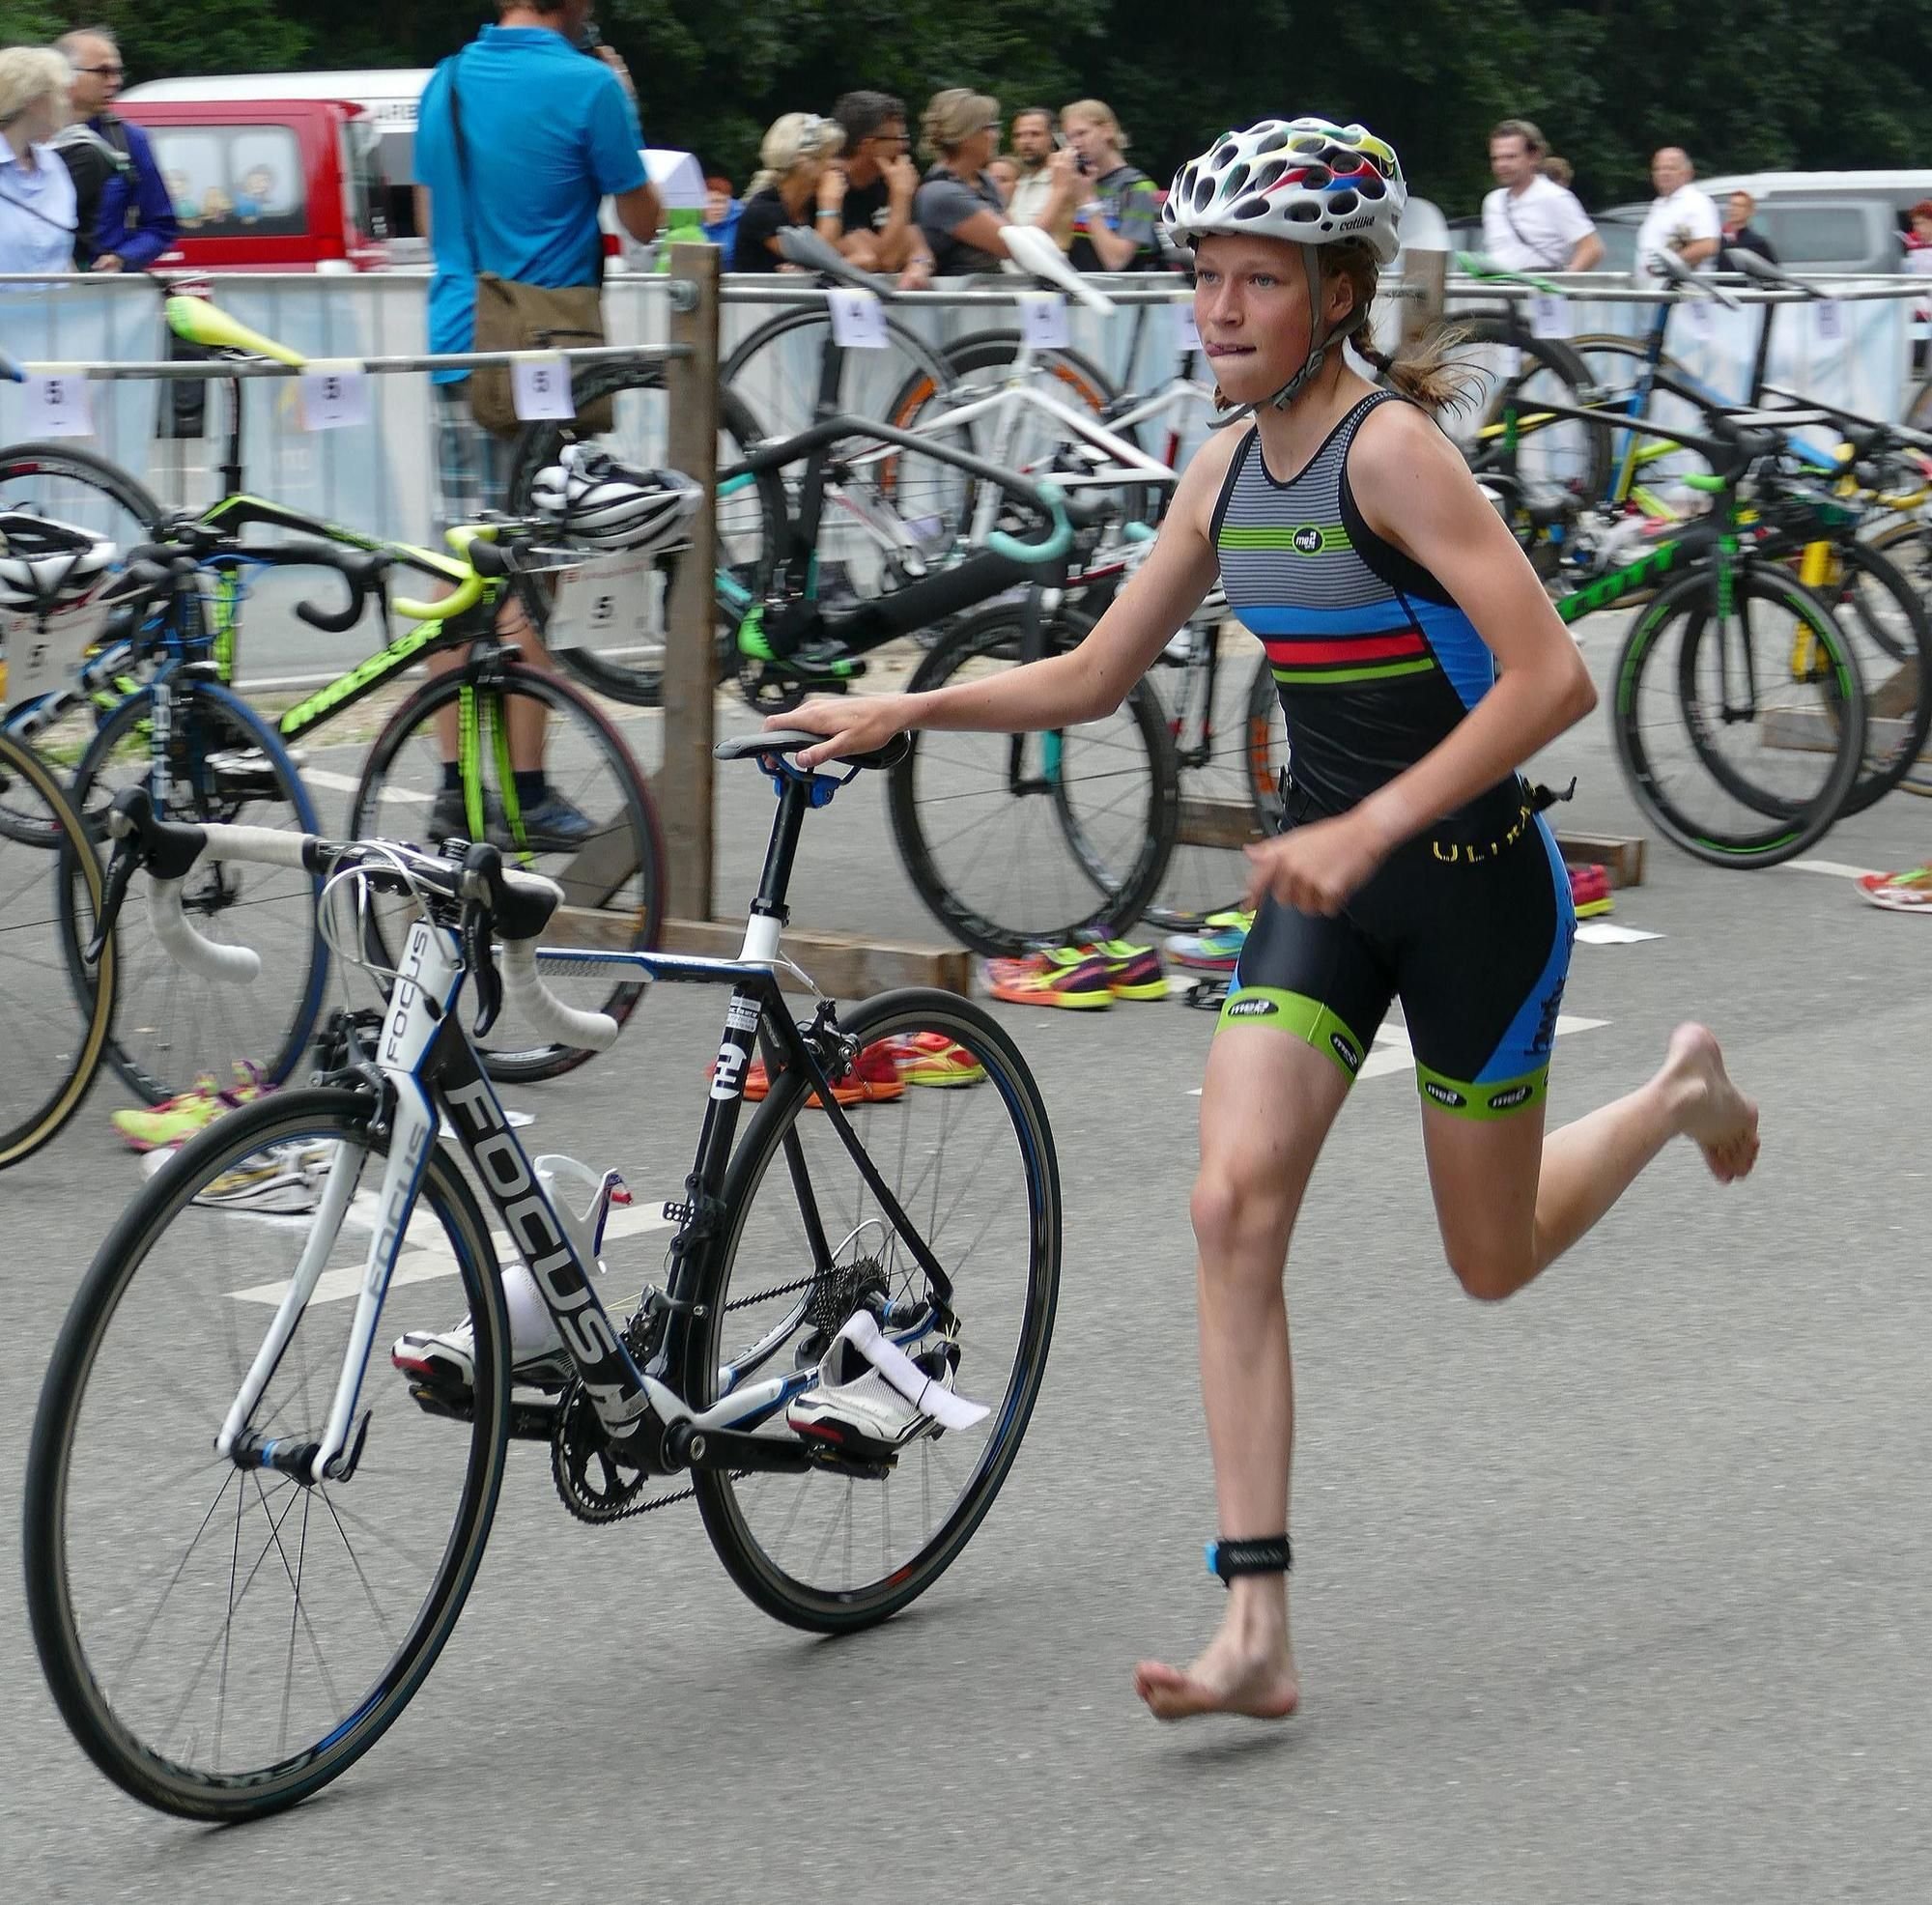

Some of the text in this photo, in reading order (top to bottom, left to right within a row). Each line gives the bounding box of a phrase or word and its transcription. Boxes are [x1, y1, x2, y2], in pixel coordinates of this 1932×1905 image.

[1339, 215, 1376, 232] catlike
[45, 380, 64, 406] 5
[324, 376, 341, 401] 5
[532, 370, 550, 393] 5
[592, 595, 616, 620] 5
[27, 642, 50, 669] 5
[386, 929, 429, 1064] FOCUS
[368, 1122, 427, 1295] FOCUS
[436, 1078, 618, 1365] FOCUS
